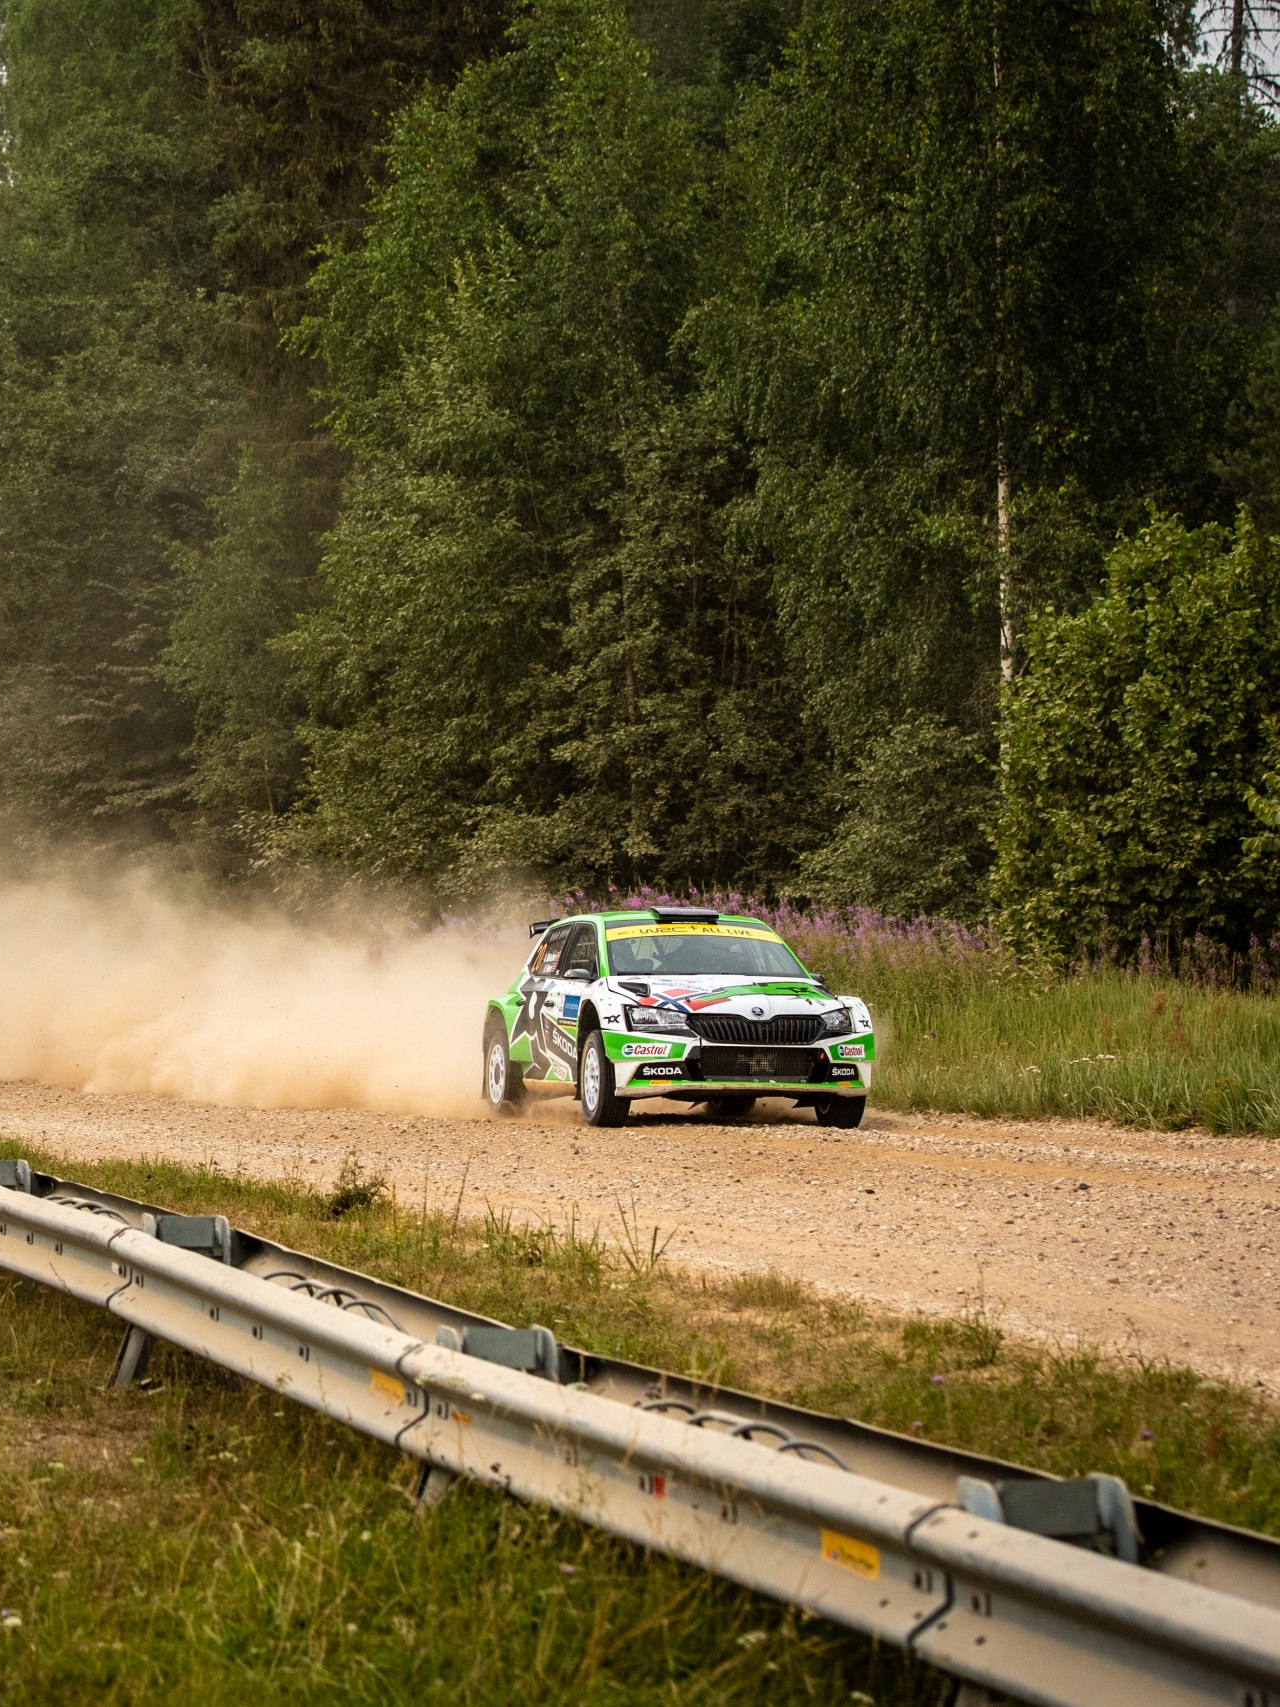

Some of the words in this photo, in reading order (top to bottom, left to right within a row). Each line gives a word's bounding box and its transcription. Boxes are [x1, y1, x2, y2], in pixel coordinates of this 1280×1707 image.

[726, 928, 754, 936] LIVE
[552, 1028, 578, 1060] ŠKODA
[634, 1044, 668, 1056] Castrol
[844, 1046, 863, 1057] Castrol
[642, 1066, 683, 1076] ŠKODA
[832, 1066, 855, 1076] ŠKODA
